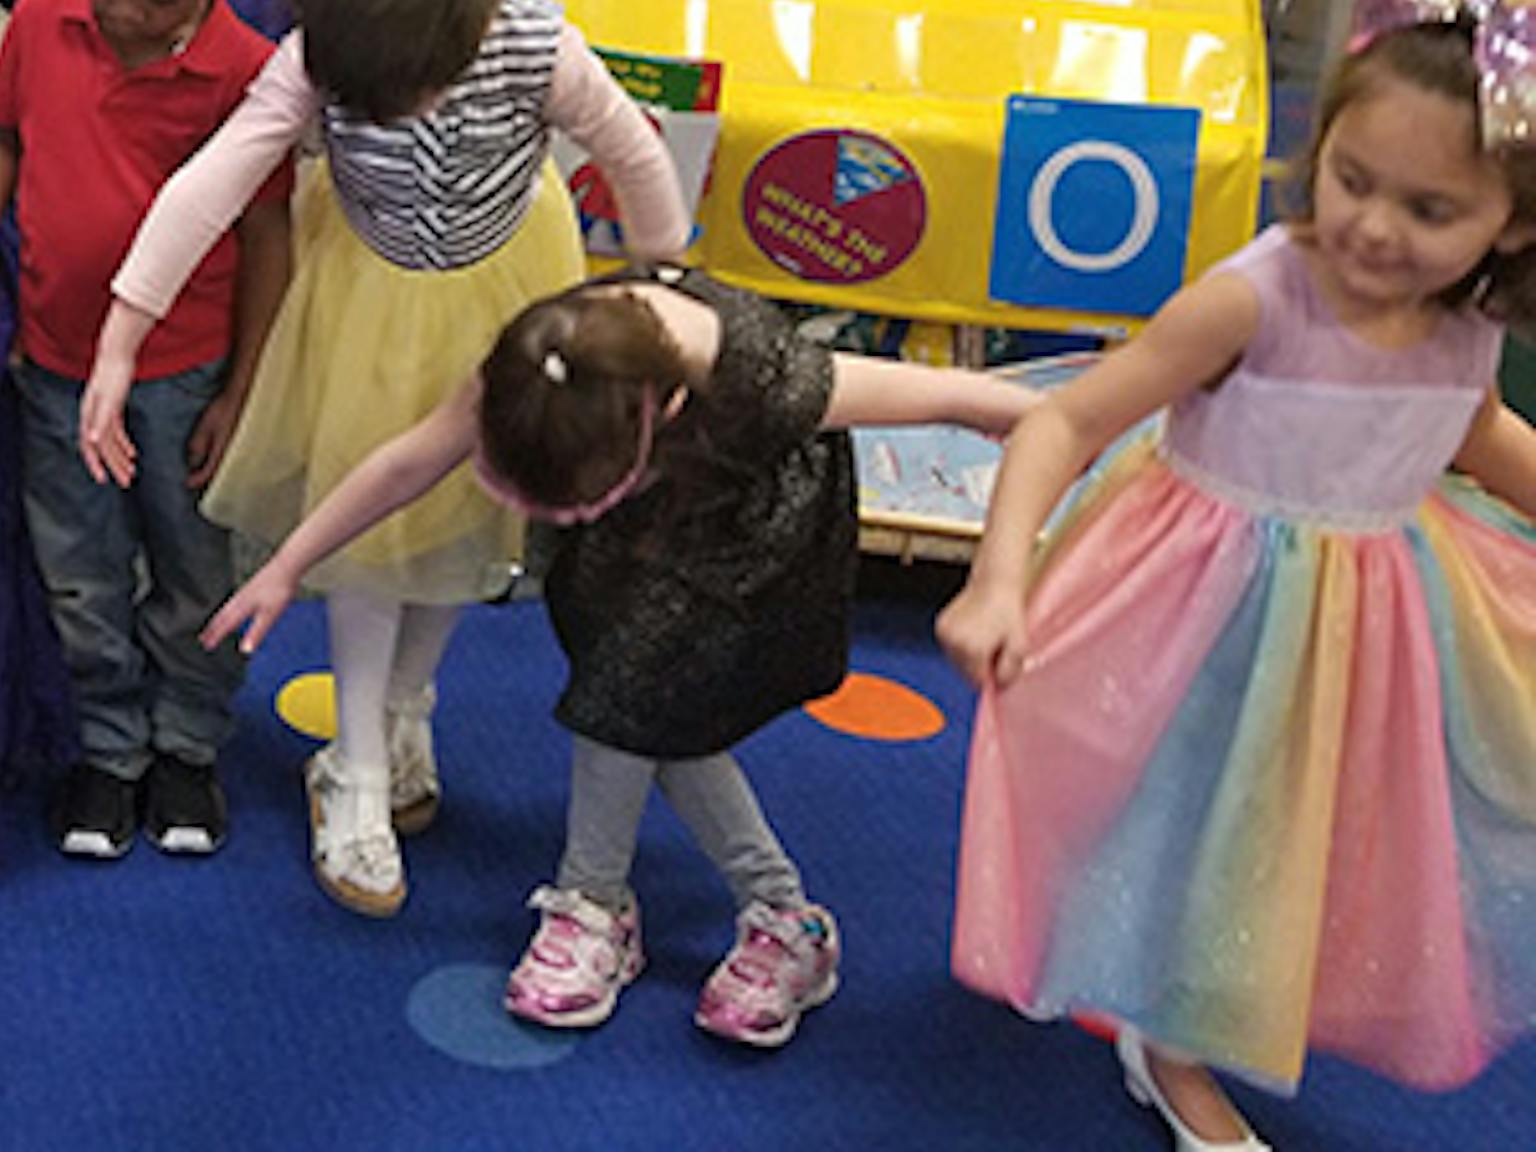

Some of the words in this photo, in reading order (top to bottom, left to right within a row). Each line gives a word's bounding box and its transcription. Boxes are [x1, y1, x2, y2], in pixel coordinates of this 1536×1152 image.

[762, 180, 843, 239] WHAT'S
[844, 227, 888, 265] THE
[1027, 139, 1159, 273] O
